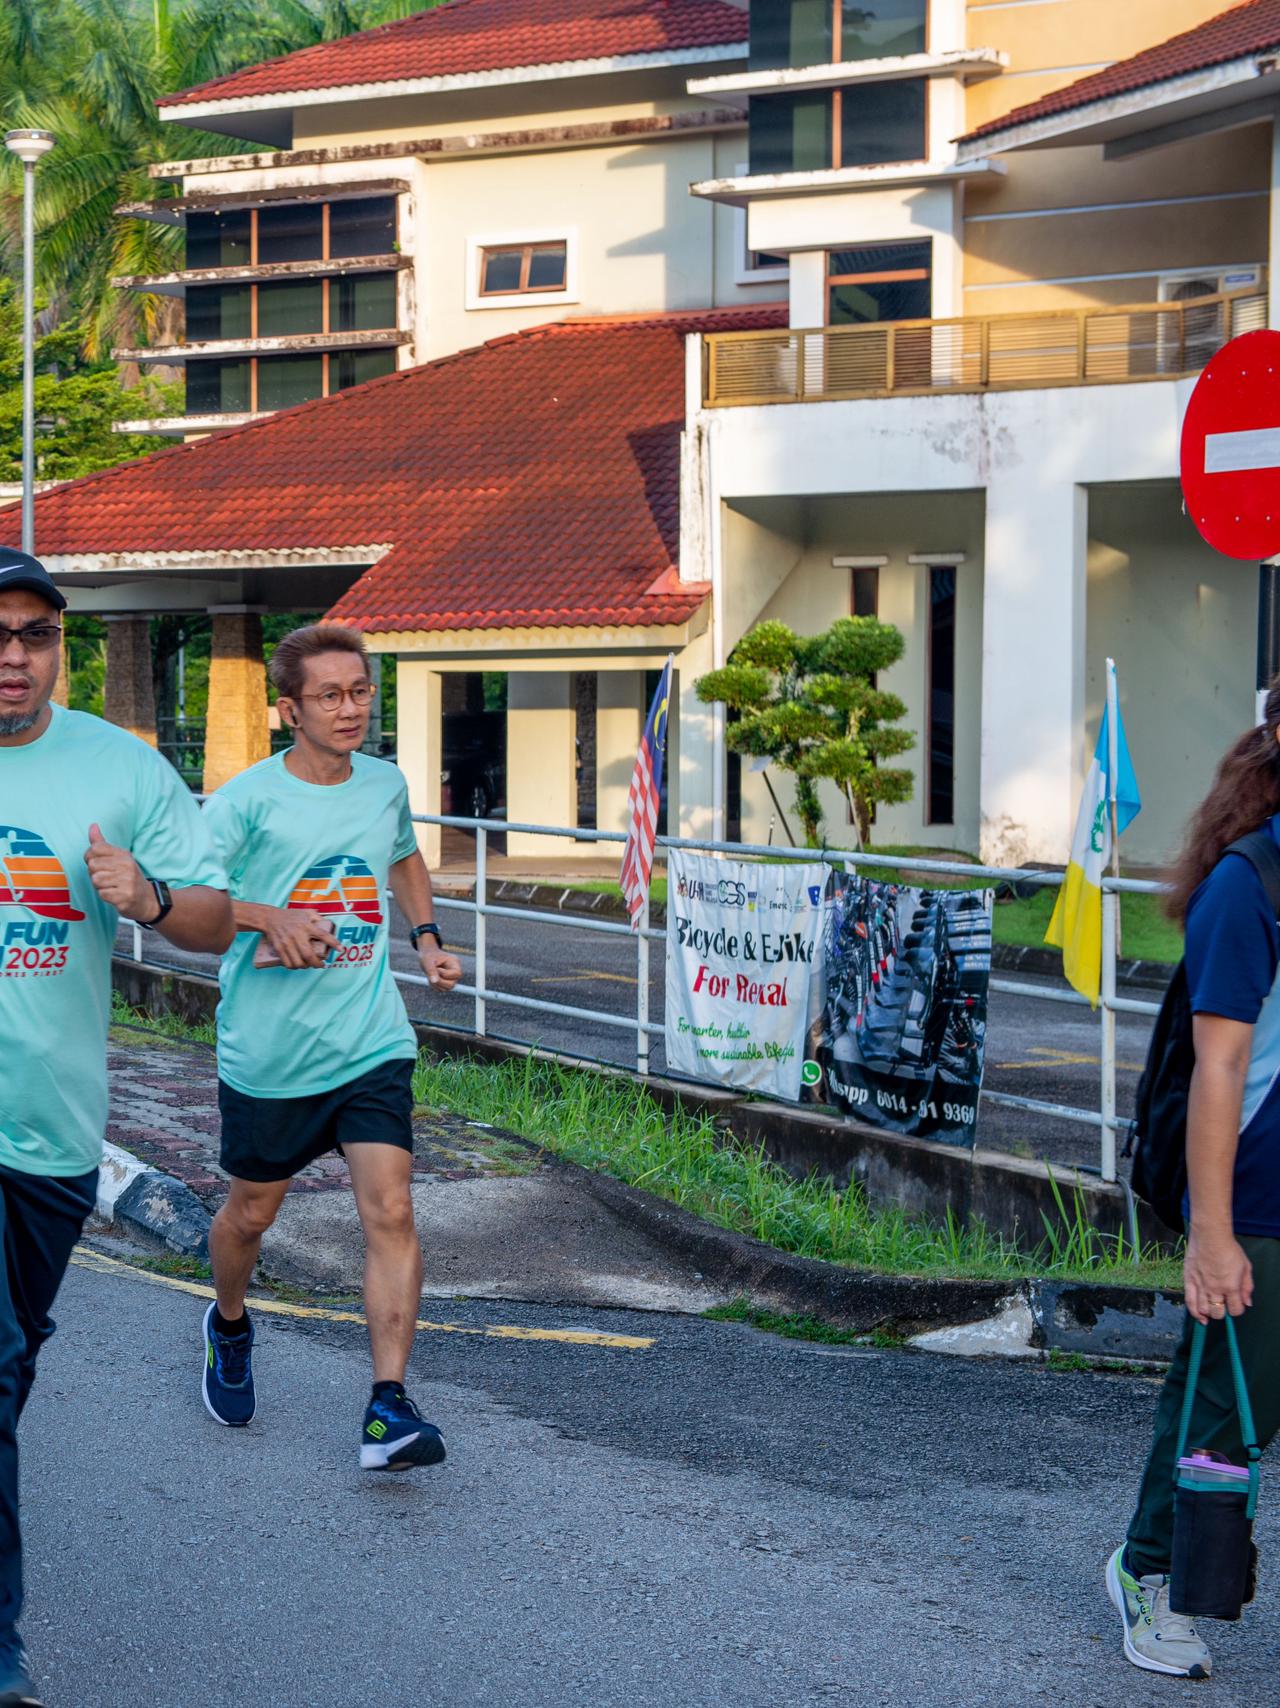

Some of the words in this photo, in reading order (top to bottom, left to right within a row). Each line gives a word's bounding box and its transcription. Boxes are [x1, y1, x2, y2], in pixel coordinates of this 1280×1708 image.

[4, 922, 69, 945] FUN
[338, 925, 378, 944] FUN
[676, 916, 738, 959] Bicycle
[743, 931, 757, 961] &
[5, 946, 70, 969] 2023
[33, 969, 64, 977] FIRST
[693, 965, 729, 998] For
